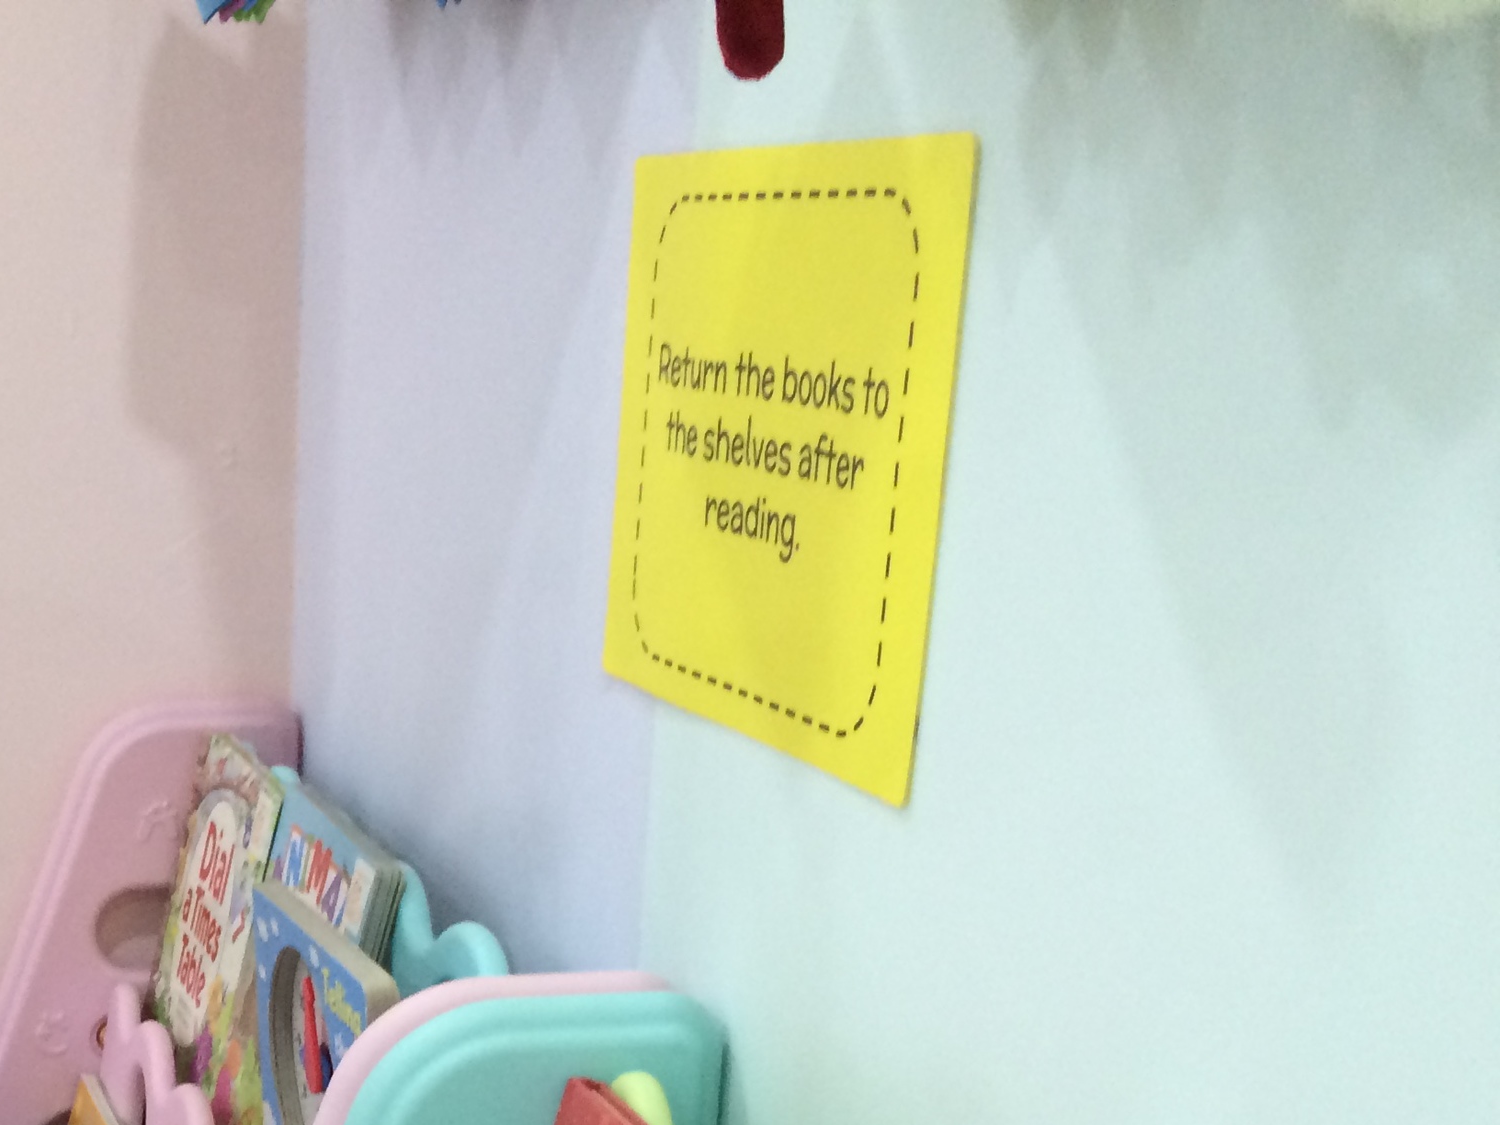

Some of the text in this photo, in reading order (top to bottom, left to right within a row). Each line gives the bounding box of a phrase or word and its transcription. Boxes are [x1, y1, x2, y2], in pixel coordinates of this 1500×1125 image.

[657, 341, 890, 419] Return the books to
[666, 409, 865, 491] the shelves after
[704, 494, 801, 564] reading.
[198, 820, 236, 906] Dial
[182, 885, 223, 963] a Times
[176, 933, 206, 1009] Table
